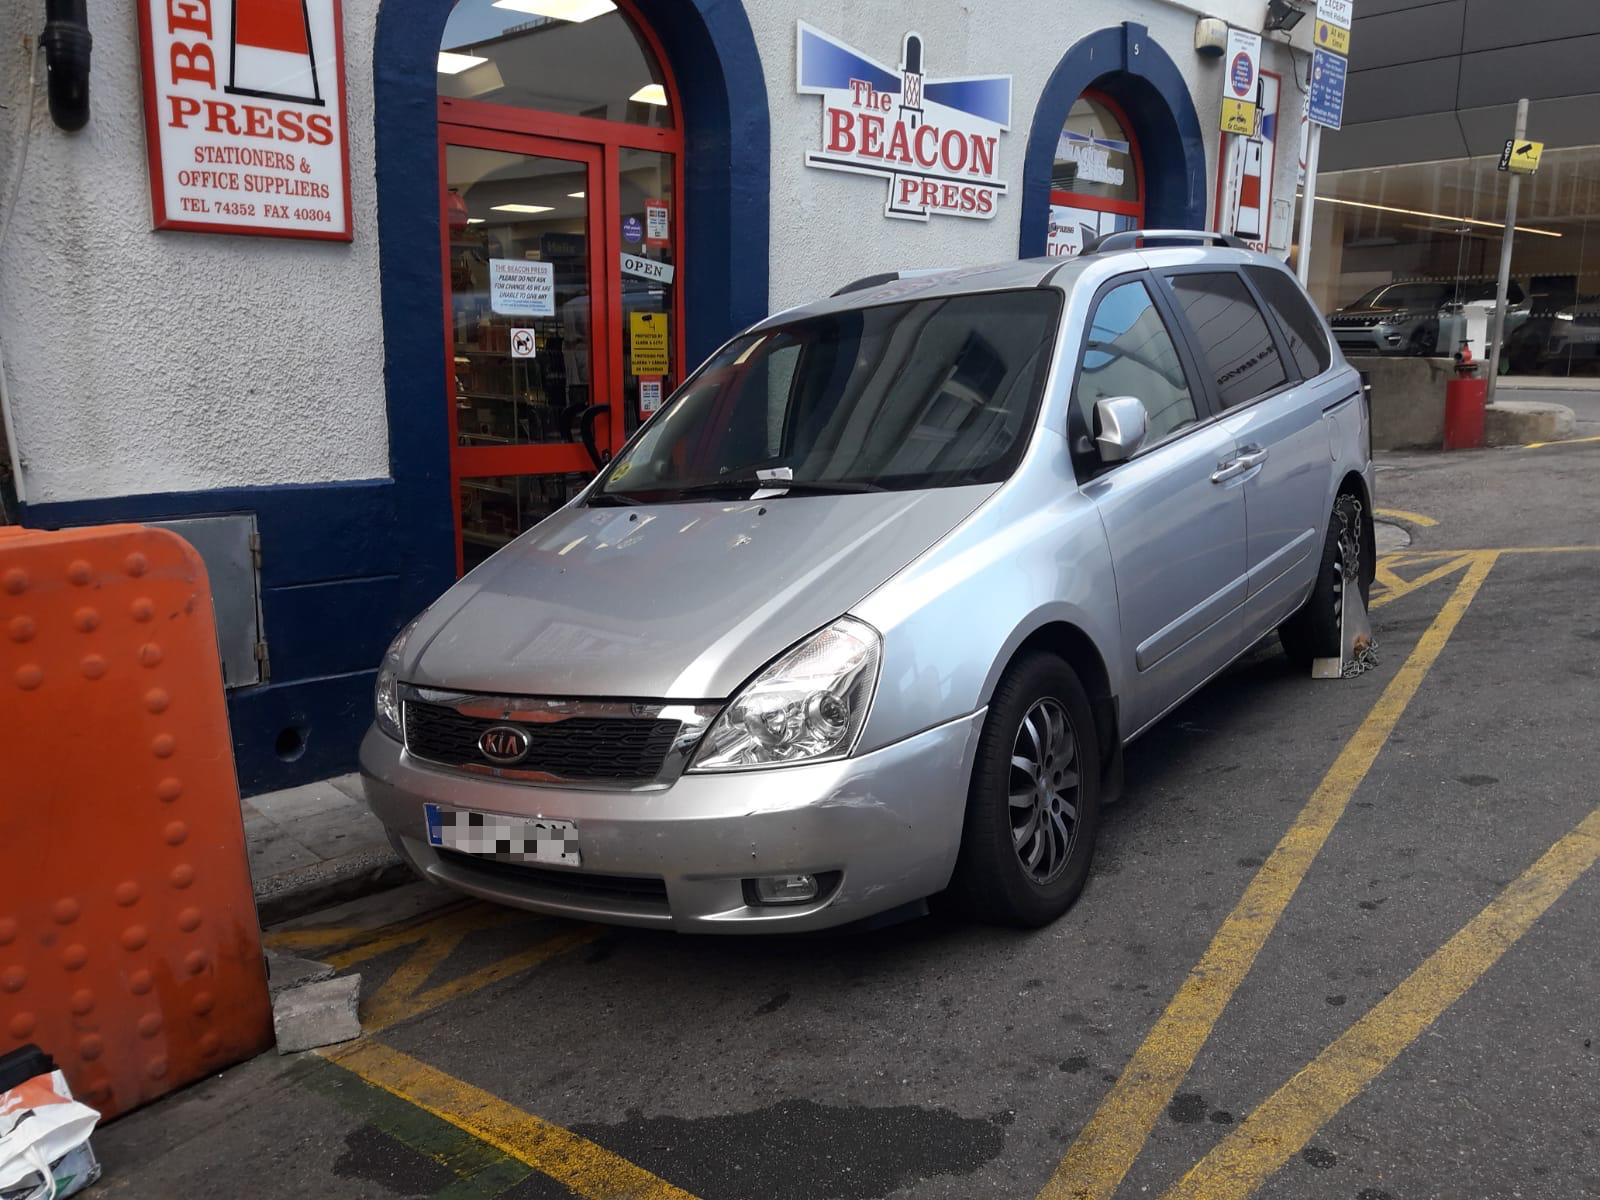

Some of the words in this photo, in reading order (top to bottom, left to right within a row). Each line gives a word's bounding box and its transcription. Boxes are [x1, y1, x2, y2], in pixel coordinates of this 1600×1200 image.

[1134, 43, 1140, 56] 5
[850, 79, 892, 112] The
[166, 95, 334, 146] PRESS
[827, 107, 998, 176] BEACON
[1501, 140, 1513, 167] CCTV
[194, 146, 295, 171] STATIONERS
[299, 158, 311, 174] &
[178, 170, 240, 190] OFFICE
[244, 174, 330, 199] SUPPLIERS
[899, 178, 993, 214] PRESS
[180, 197, 210, 214] TEL
[214, 202, 256, 217] 74352
[263, 204, 290, 220] FAX
[293, 207, 332, 223] 40304
[624, 258, 664, 278] OPEN
[484, 732, 519, 755] KIA
